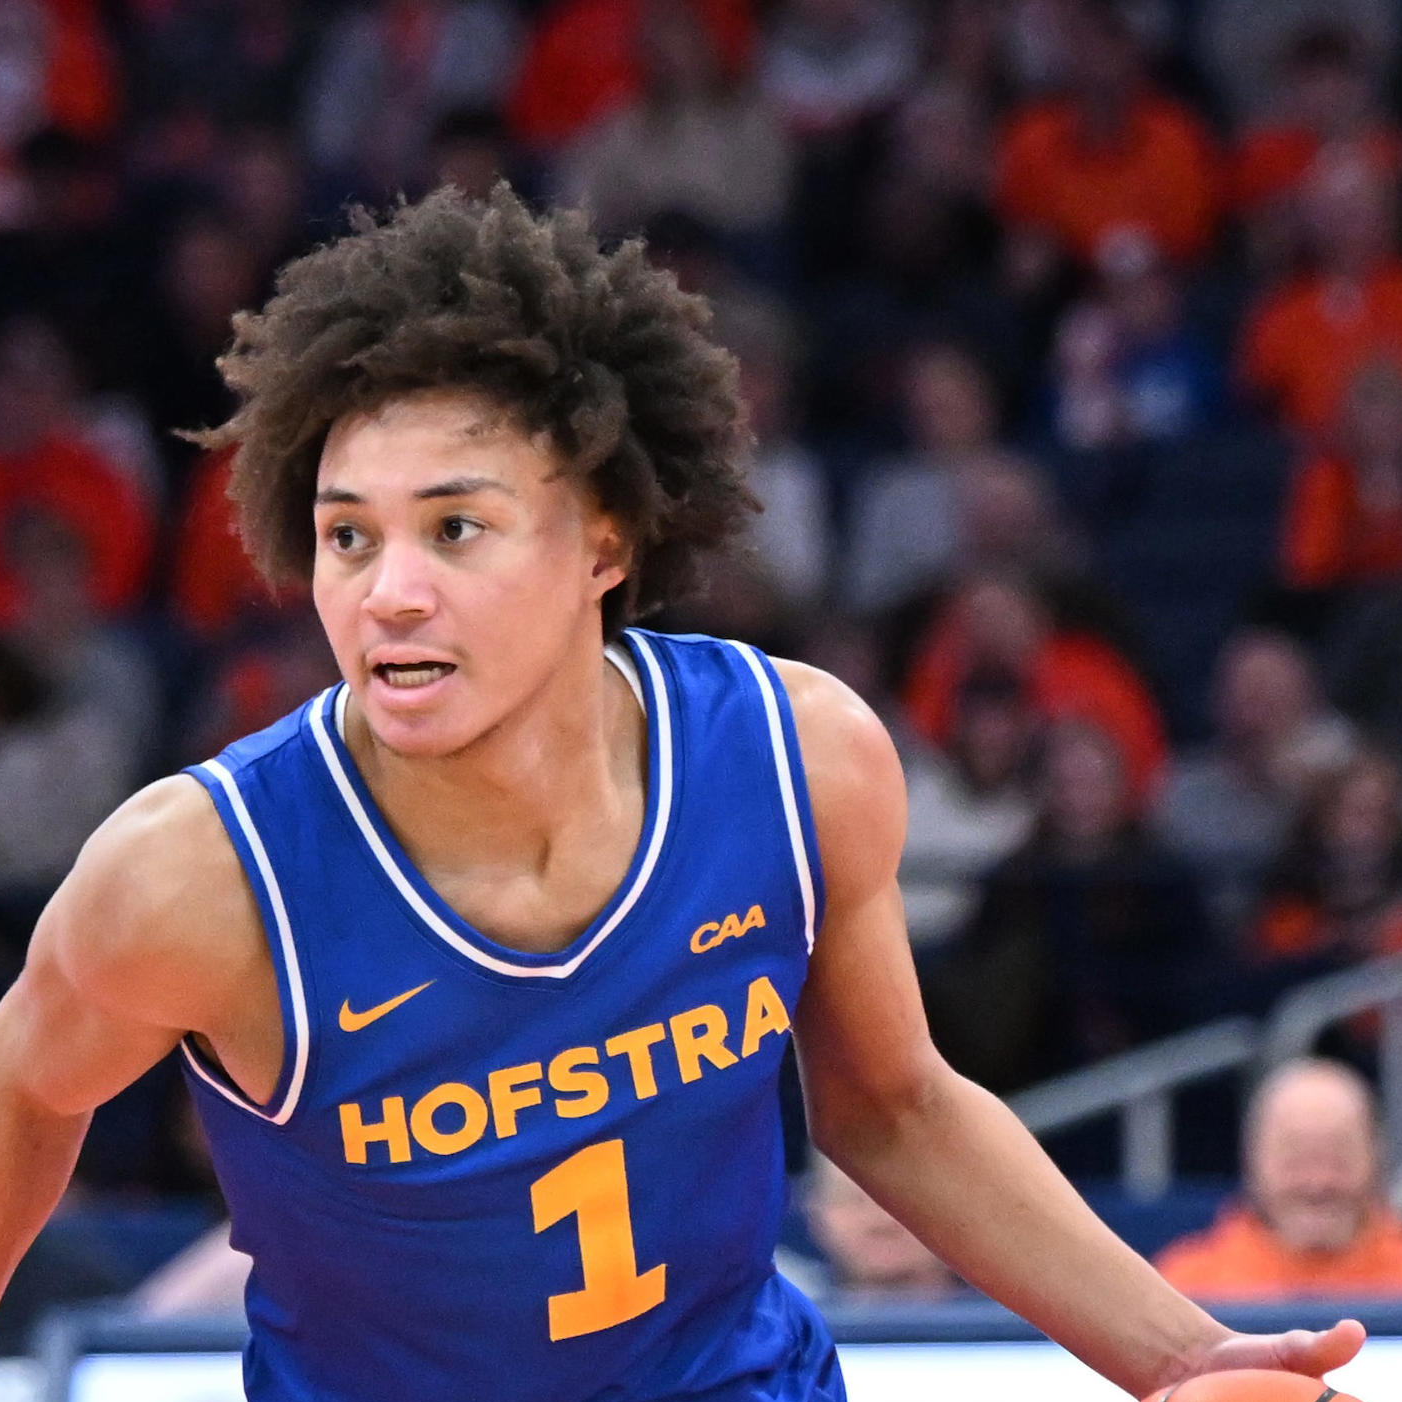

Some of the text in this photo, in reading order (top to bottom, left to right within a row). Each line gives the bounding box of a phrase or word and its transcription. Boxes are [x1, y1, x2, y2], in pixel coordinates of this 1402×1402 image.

[690, 904, 766, 953] CAA
[339, 976, 792, 1164] HOFSTRA
[530, 1139, 666, 1342] 1
